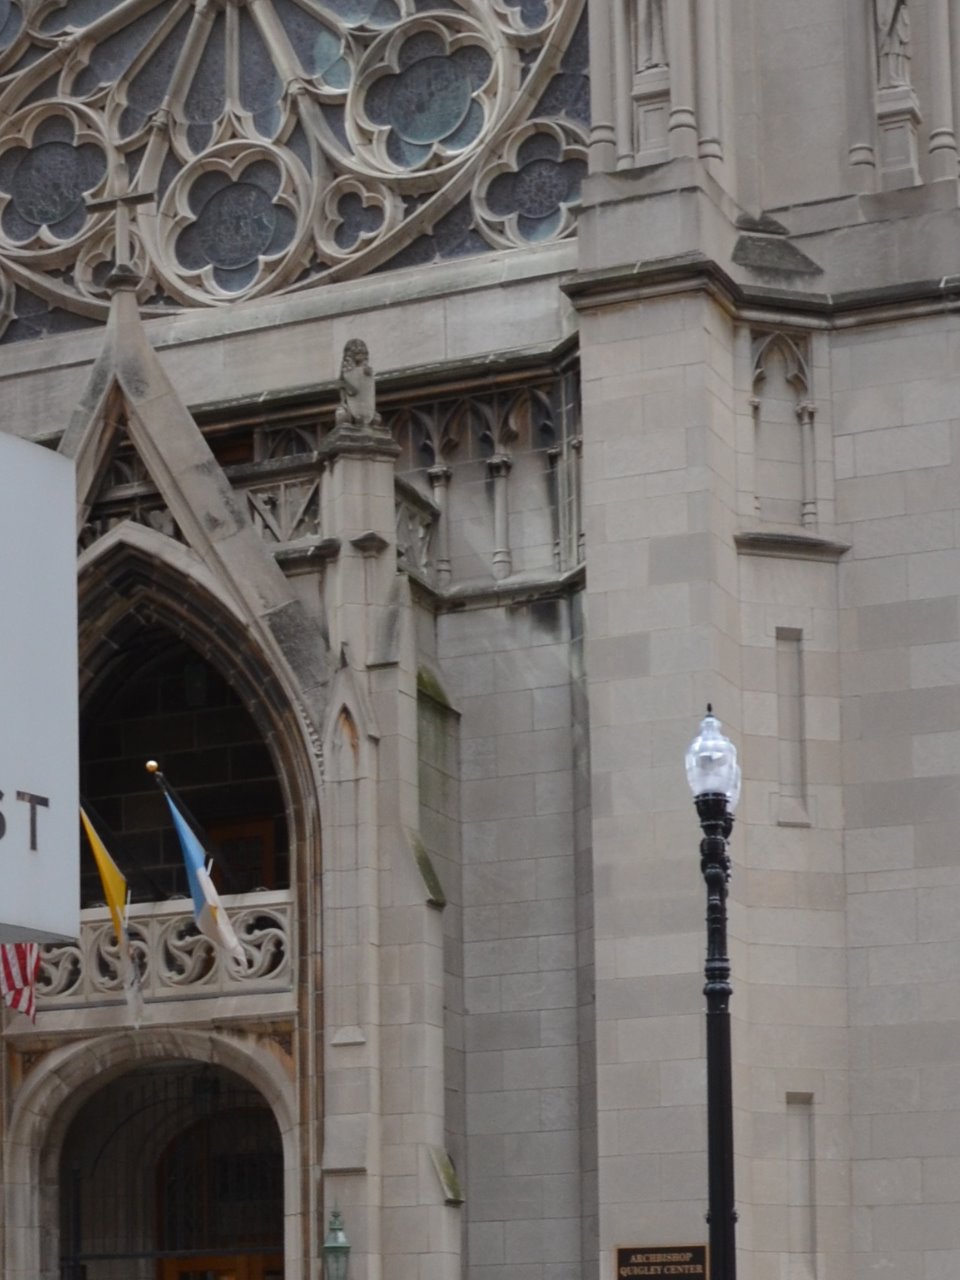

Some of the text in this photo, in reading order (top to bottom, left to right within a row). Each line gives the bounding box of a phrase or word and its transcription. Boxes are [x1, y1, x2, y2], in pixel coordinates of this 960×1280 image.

[630, 1252, 693, 1263] ARCHBISHOP
[619, 1264, 704, 1277] QUIGLEY CENTER
